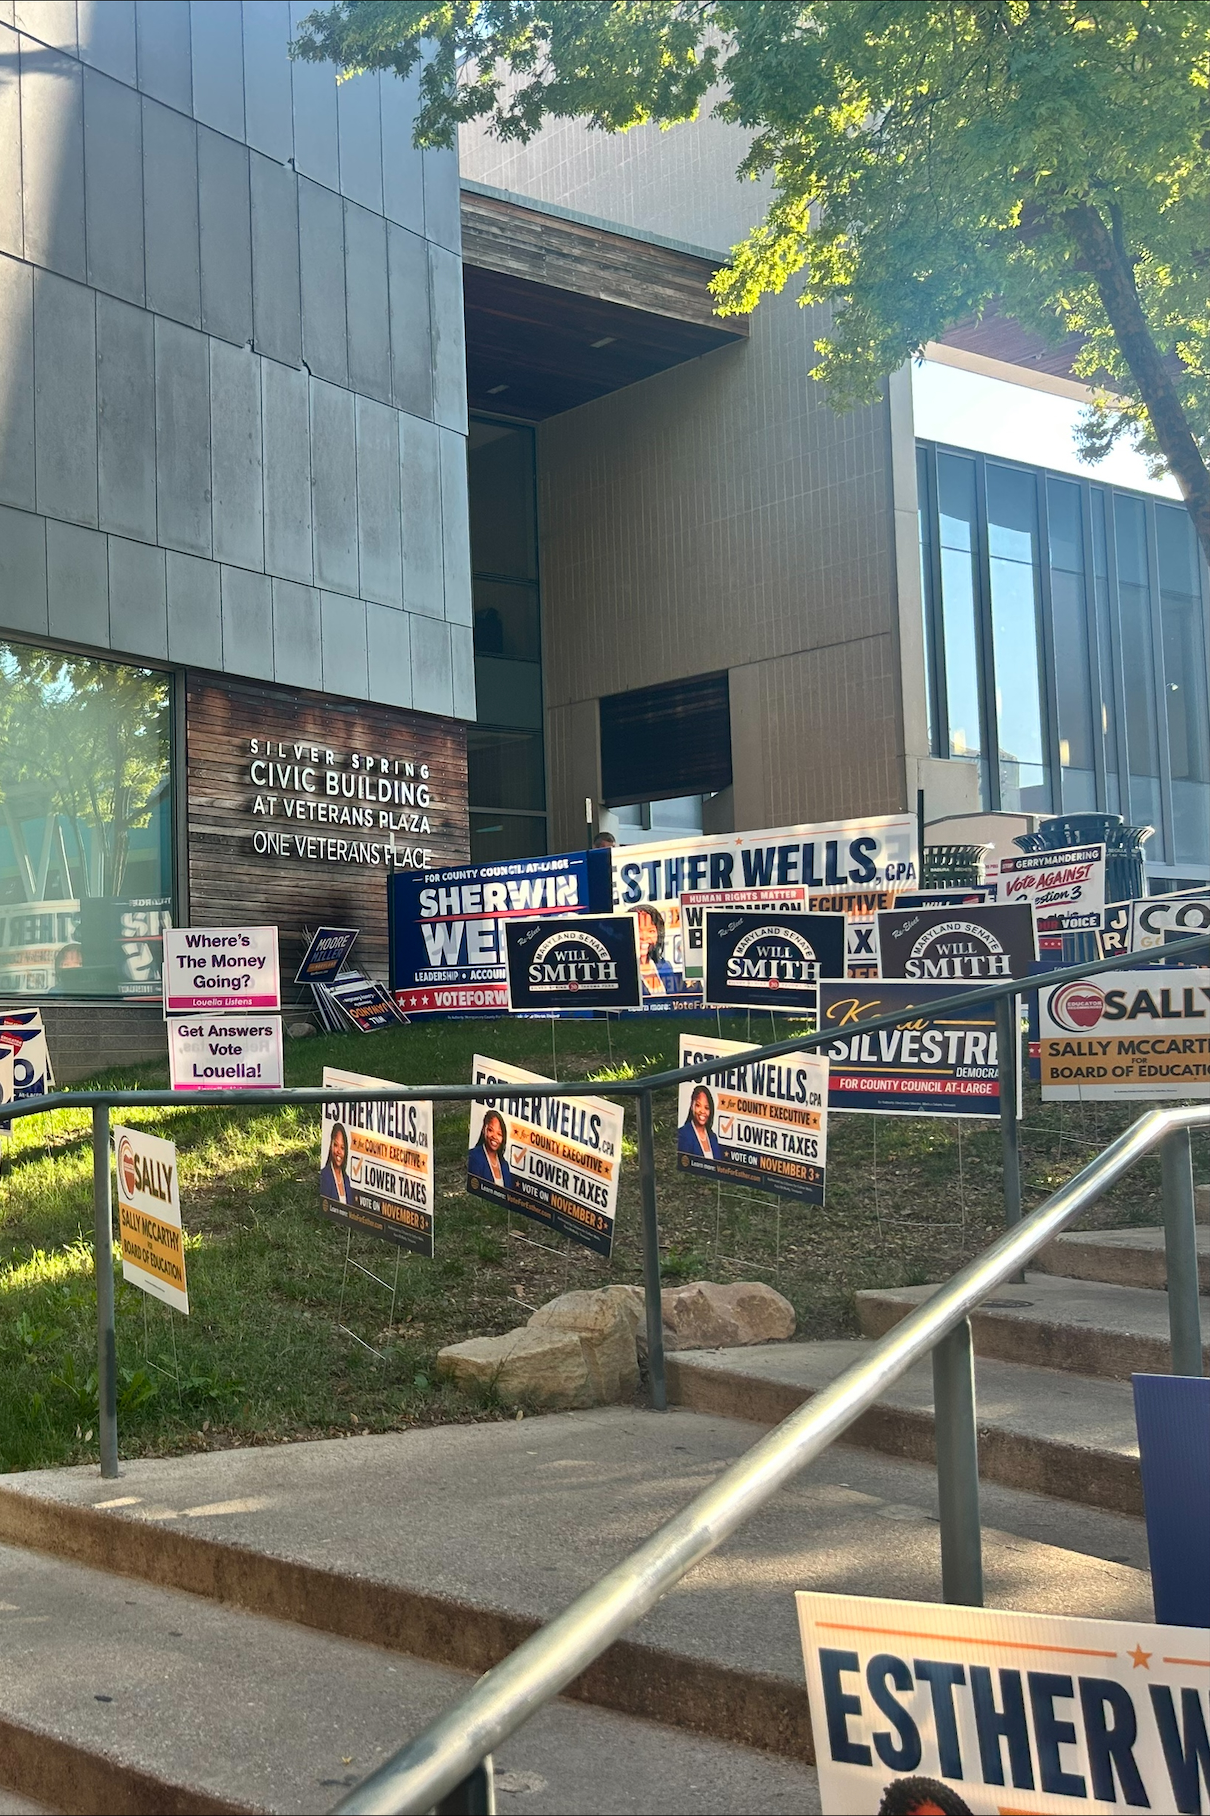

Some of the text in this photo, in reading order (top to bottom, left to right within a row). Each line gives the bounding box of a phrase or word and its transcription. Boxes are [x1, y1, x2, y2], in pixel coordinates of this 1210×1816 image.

[250, 738, 430, 779] SILVER SPRING
[250, 760, 430, 808] CIVIC BUILDING
[253, 795, 431, 834] AT VETERANS PLAZA
[253, 831, 432, 869] ONE VETERANS PLACE
[741, 837, 916, 887] WELLS, CPA
[1016, 850, 1099, 868] GERRYMANDERING
[424, 859, 569, 883] FOR COUNTY COUNCIL AT-LARGE
[1006, 863, 1094, 896] Vote AGAINST
[419, 875, 579, 918] SHERWIN
[689, 890, 797, 904] HUMAN RIGHTS MATTER
[1071, 885, 1082, 900] 3
[891, 916, 920, 940] Re-Elect
[1061, 916, 1097, 929] VOICE
[185, 934, 250, 948] Where's
[316, 935, 350, 951] MOORE
[536, 933, 608, 960] MARYLAND SENATE
[736, 927, 812, 957] MARYLAND SENATE
[756, 946, 793, 959] WILL
[913, 923, 999, 955] MARYLAND SENATE
[935, 942, 977, 955] WILL
[176, 954, 266, 969] The Money
[311, 948, 344, 962] MILLER
[554, 950, 590, 961] WILL
[905, 954, 1012, 979] SMITH
[193, 975, 251, 990] Going?
[415, 970, 459, 982] LEADERSHIP
[528, 962, 618, 983] SMITH
[727, 958, 822, 980] SMITH
[193, 998, 252, 1006] Louella Listens
[178, 1025, 273, 1037] Get Answers
[209, 1043, 242, 1055] Vote
[1048, 1041, 1112, 1057] SALLY
[193, 1063, 261, 1078] Louella!
[1050, 1065, 1134, 1079] BOARD OF
[751, 1063, 809, 1107] WELLS,
[809, 1092, 821, 1107] CPA
[840, 1078, 992, 1094] FOR COUNTY COUNCIL AT-LARGE
[376, 1100, 429, 1149] WELLS, CPA
[726, 1098, 811, 1126] for COUNTY EXECUTIVE
[543, 1097, 602, 1151] WELLS,
[602, 1141, 615, 1157] CPA
[365, 1139, 421, 1168] COUNTY EXECUTIVE
[519, 1131, 603, 1173] for COUNTY EXECUTIVE
[737, 1123, 818, 1159] LOWER TAXES
[134, 1156, 174, 1204] SALLY
[730, 1151, 815, 1182] VOTE ON NOVEMBER 3
[364, 1165, 427, 1205] LOWER TAXES
[529, 1155, 608, 1208] LOWER TAXES
[359, 1196, 425, 1230] VOTE ON NOVEMBER 3
[522, 1182, 538, 1197] VOTE
[539, 1189, 550, 1202] ON
[550, 1193, 596, 1227] NOVEMBER
[596, 1215, 603, 1231] 3
[122, 1208, 180, 1251] SALLY MCCARTHY
[124, 1240, 183, 1282] BOARD OF EDUCATION
[818, 1645, 1152, 1810] ESTHER
